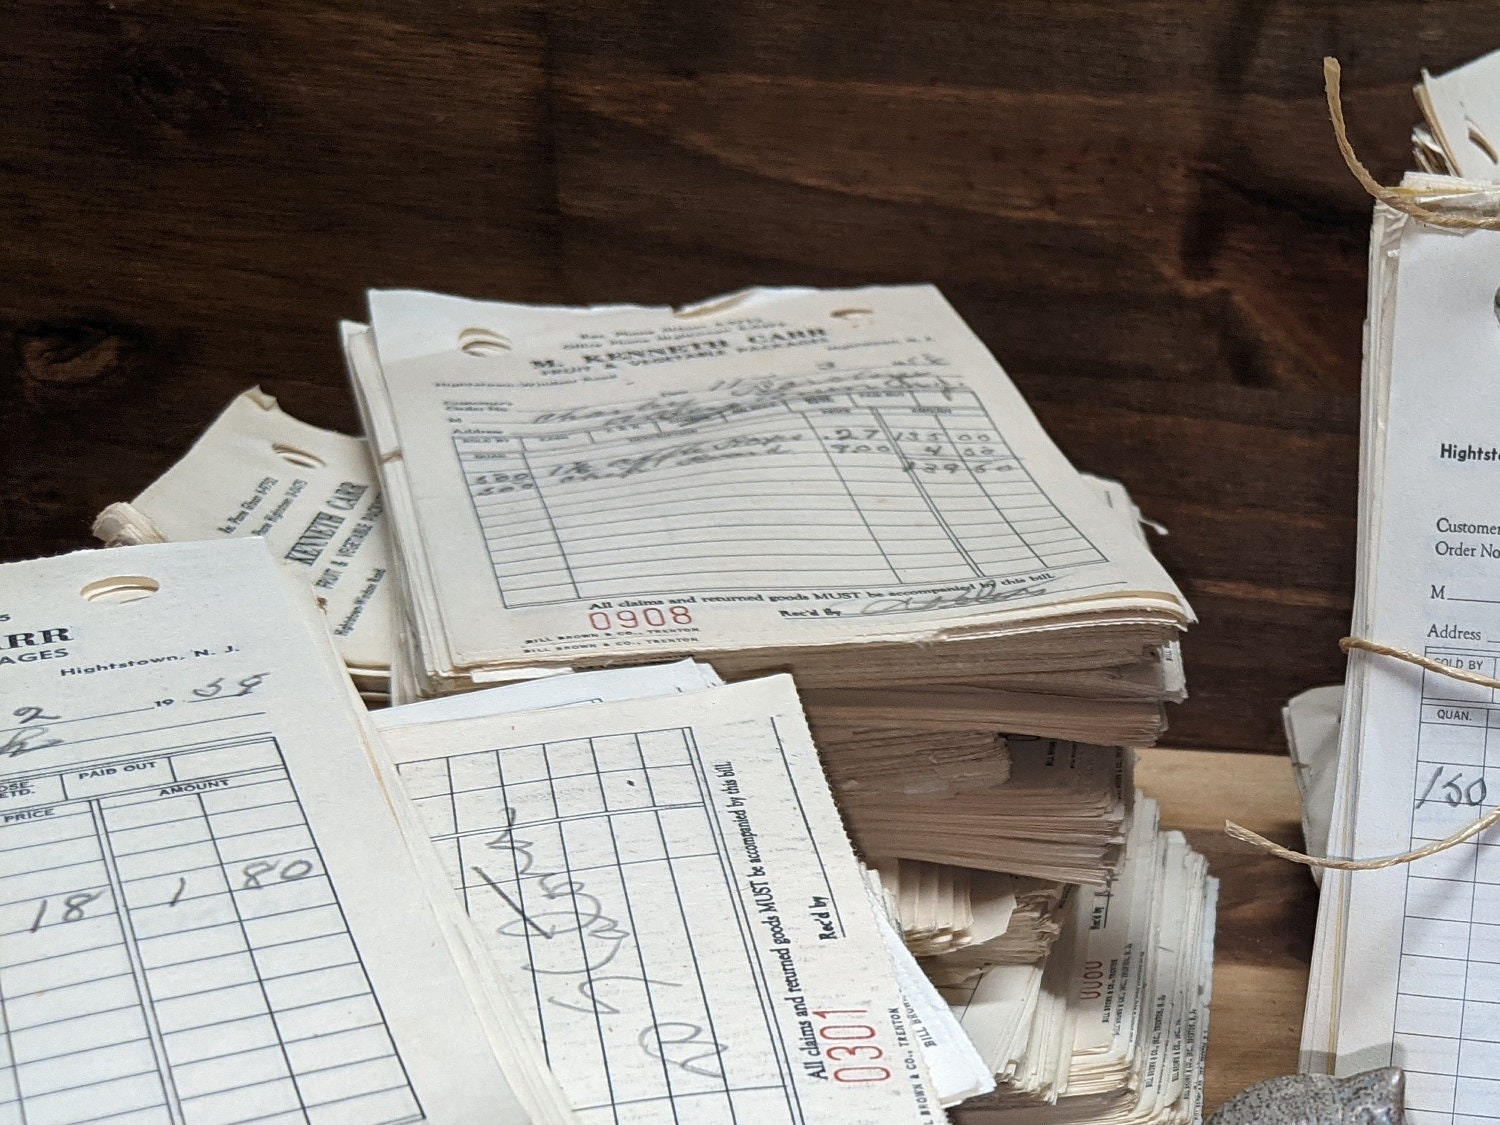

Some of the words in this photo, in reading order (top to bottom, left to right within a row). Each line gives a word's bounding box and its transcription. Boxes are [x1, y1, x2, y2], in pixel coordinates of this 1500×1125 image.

[284, 511, 347, 567] KENNETH
[326, 481, 369, 511] CARR
[1435, 541, 1476, 558] Order
[588, 601, 612, 610] All
[619, 598, 664, 608] claims
[669, 596, 697, 605] and
[702, 594, 763, 603] returned
[812, 591, 861, 601] MUST
[1431, 585, 1446, 600] M
[588, 606, 693, 631] 0908
[1427, 623, 1481, 641] Address
[61, 653, 186, 677] Hightstown,
[194, 648, 217, 658] N.
[1468, 660, 1484, 671] BY
[1437, 709, 1472, 722] QUAN.
[78, 768, 118, 780] PAID
[124, 761, 157, 772] OUT
[159, 779, 230, 797] AMOUNT
[721, 779, 740, 795] this
[726, 797, 748, 808] by
[3, 808, 56, 824] PRICE
[727, 809, 761, 864] accompanied
[746, 866, 766, 878] be
[750, 880, 778, 914] MUST
[808, 896, 830, 908] by
[761, 915, 791, 945] goods
[811, 912, 838, 940] Rec'd
[769, 948, 801, 993] returned
[784, 997, 808, 1018] and
[888, 1007, 909, 1047] TRENTON
[799, 1020, 821, 1057] claims
[812, 1009, 891, 1083] 0301
[916, 1026, 937, 1048] BILL
[803, 1061, 828, 1080] All
